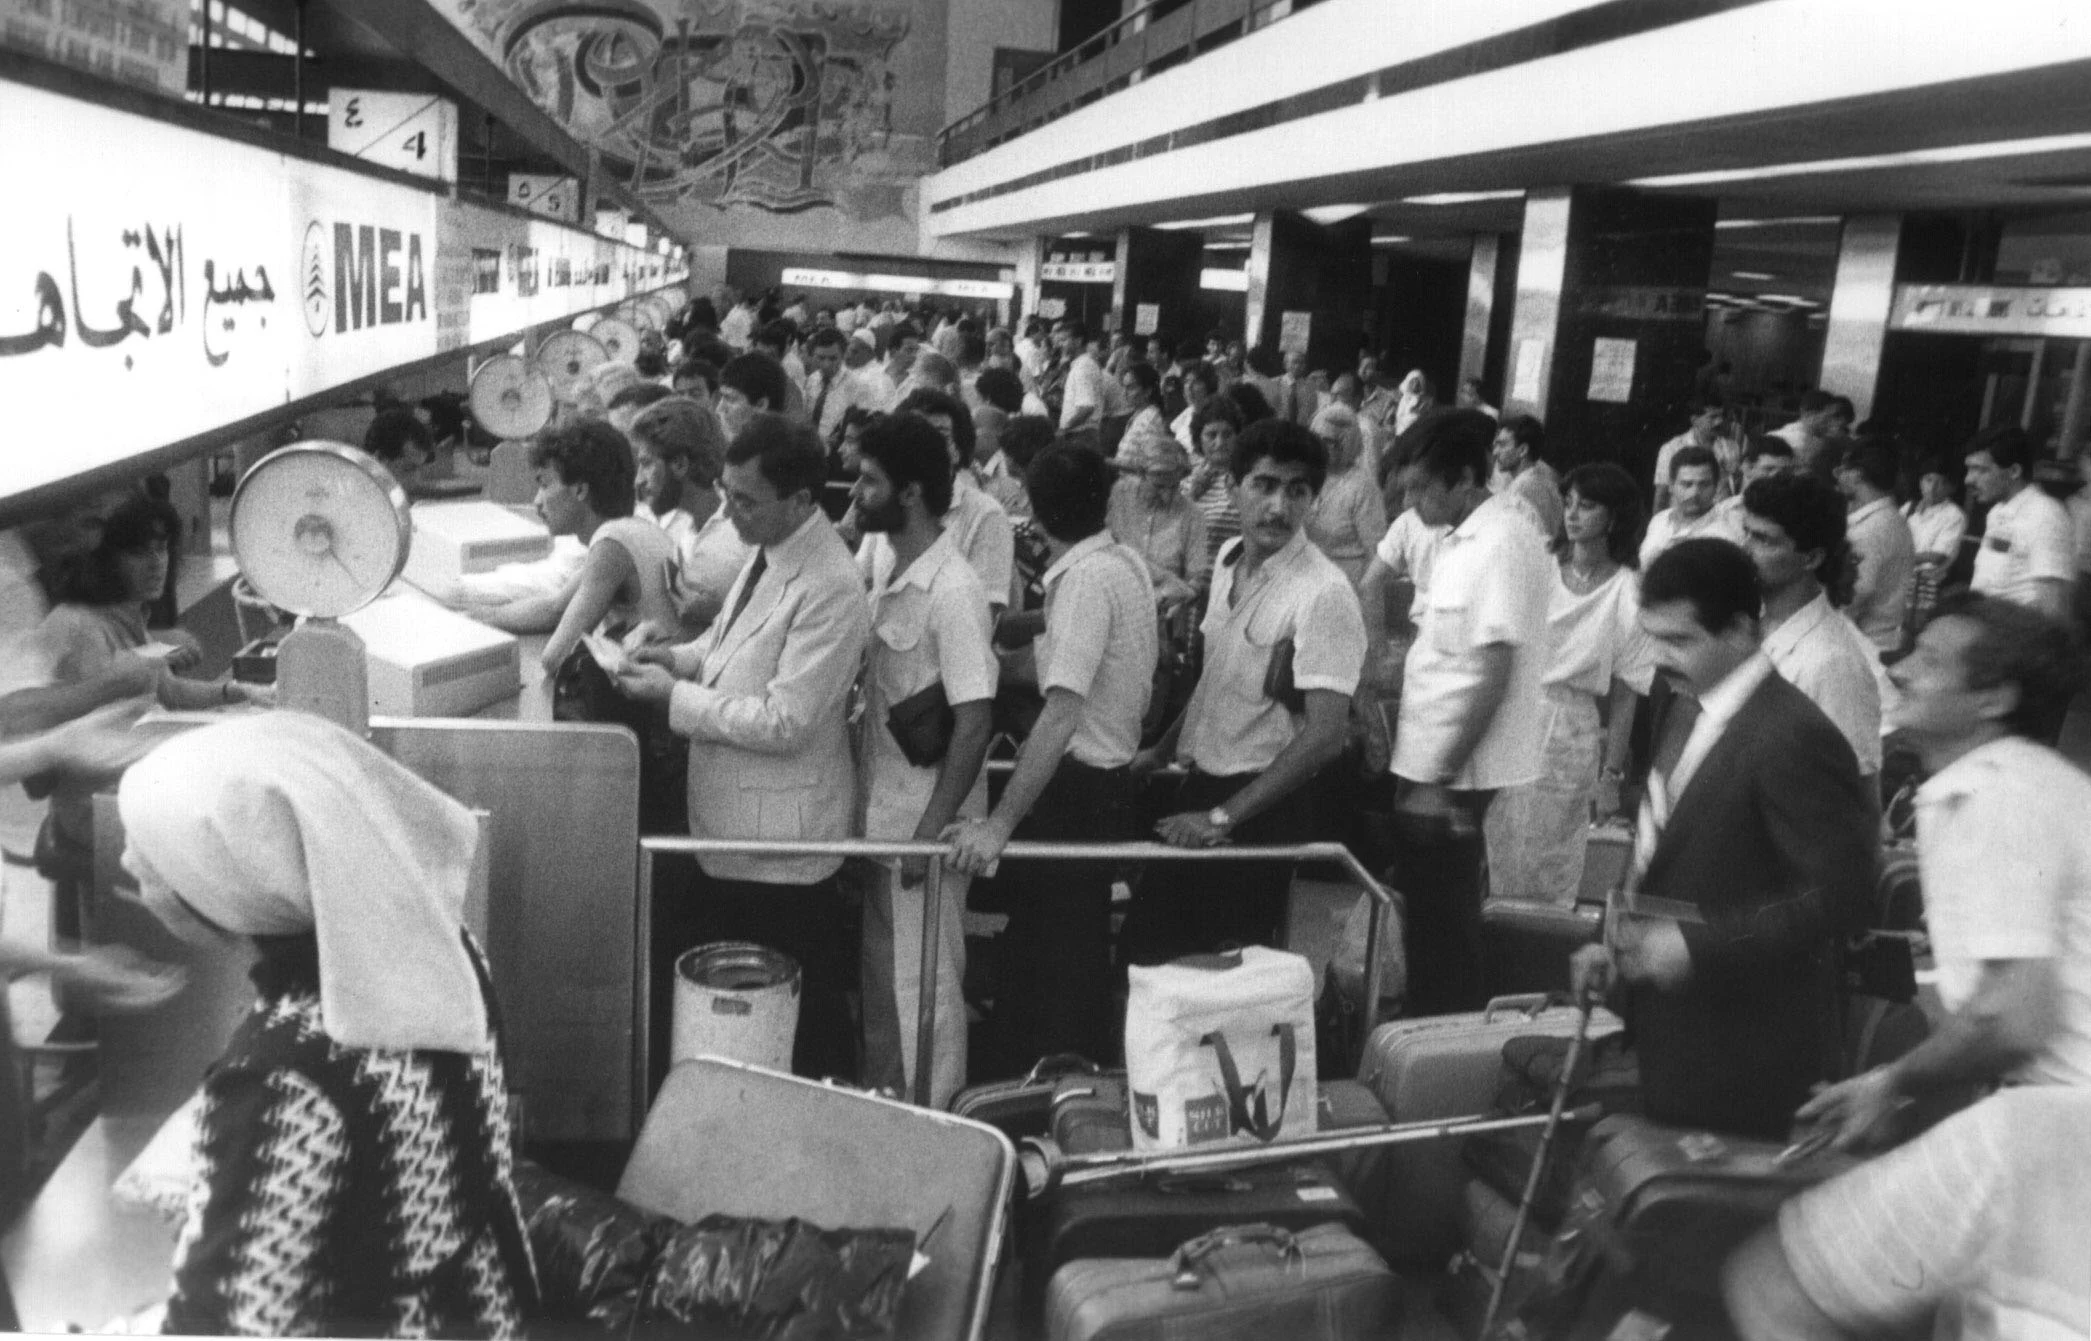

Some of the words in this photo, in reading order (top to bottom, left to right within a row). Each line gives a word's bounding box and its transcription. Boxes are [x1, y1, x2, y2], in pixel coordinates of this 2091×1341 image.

[345, 97, 363, 128] ٤
[402, 131, 426, 160] 4
[0, 213, 185, 372] الاتجاه
[203, 258, 275, 367] جميع
[334, 221, 426, 334] MEA
